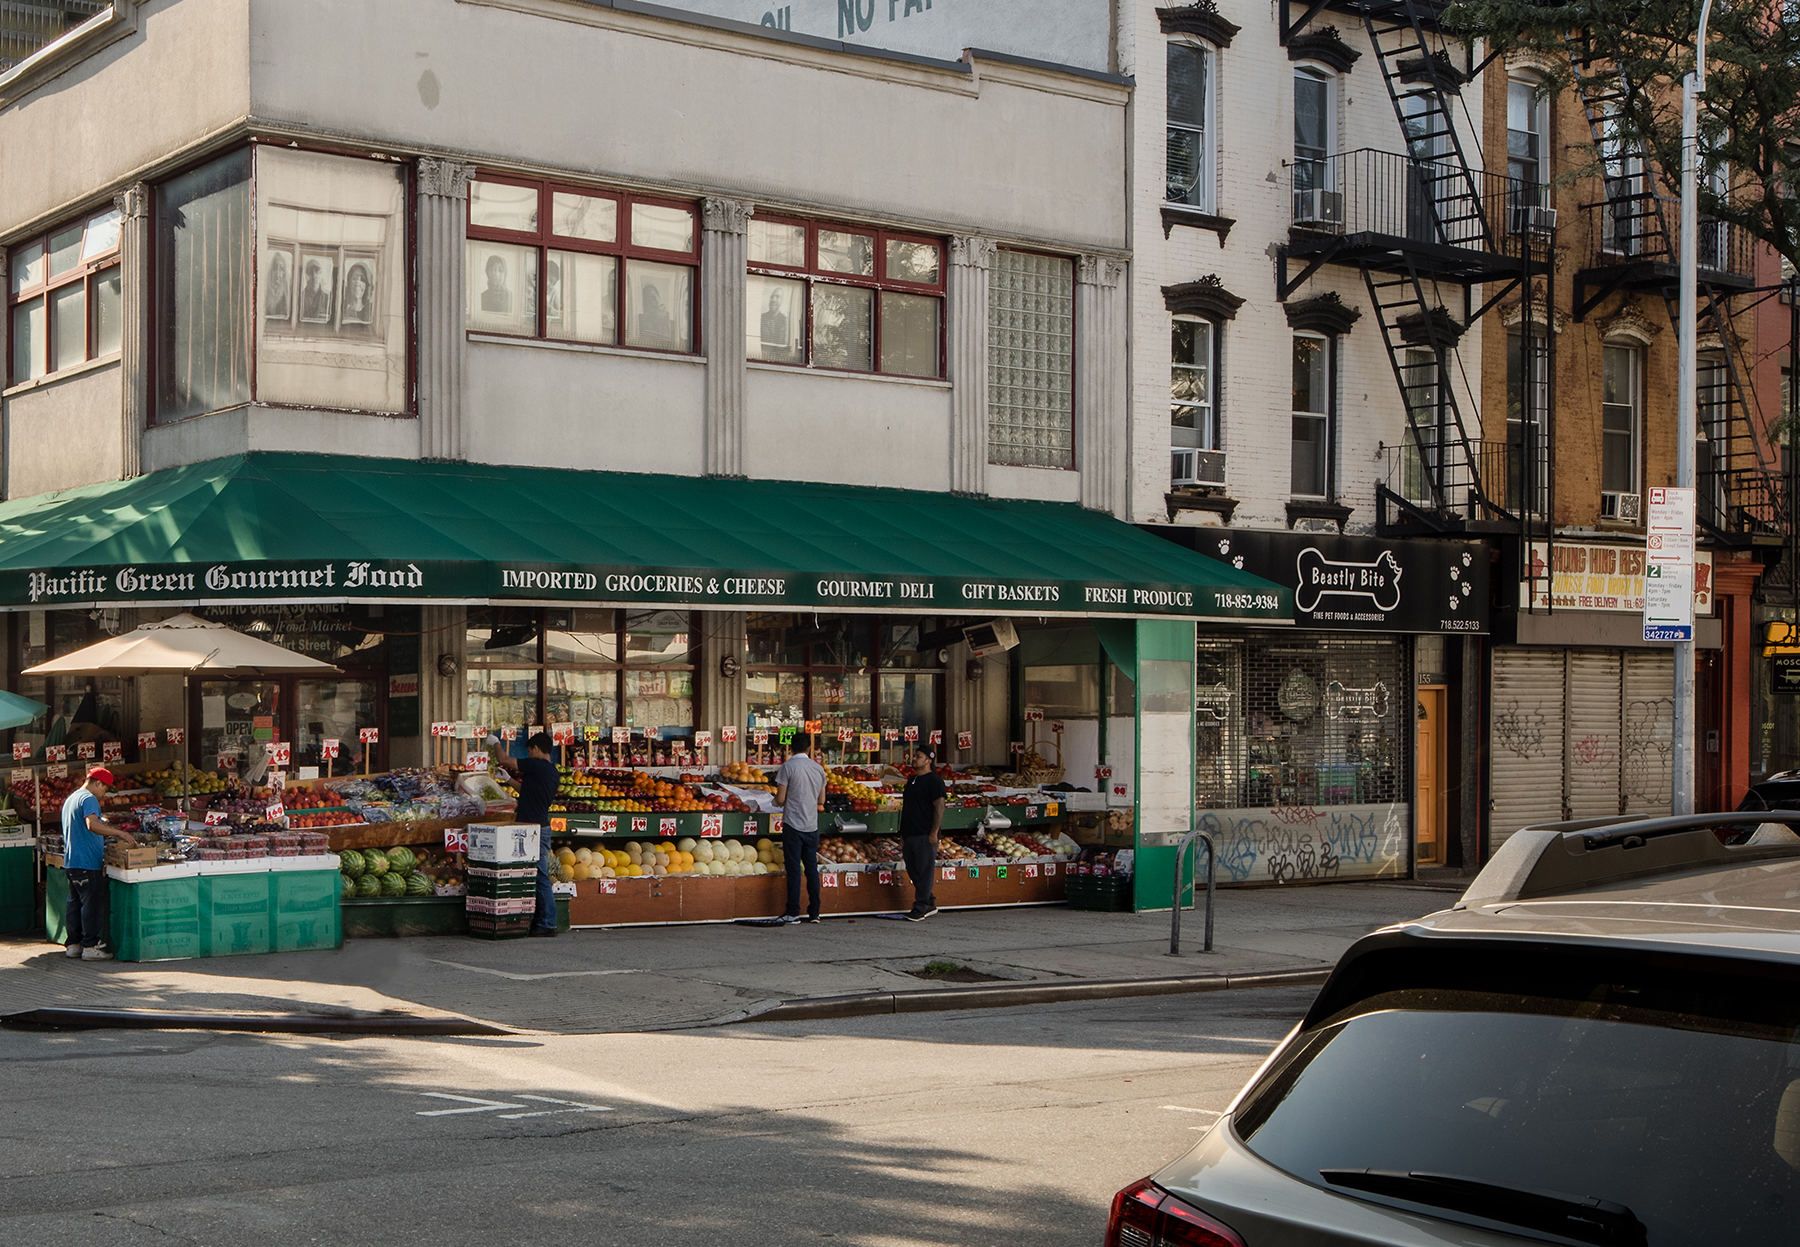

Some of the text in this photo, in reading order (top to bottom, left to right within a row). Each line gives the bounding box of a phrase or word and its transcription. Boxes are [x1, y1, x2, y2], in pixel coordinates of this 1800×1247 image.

[1553, 546, 1586, 573] HUNG
[1312, 567, 1385, 590] Beastly Bite
[1650, 565, 1658, 577] 2
[28, 561, 423, 603] Pacific Green Gourmet Food
[502, 569, 786, 597] IMPORTED GROCERIES & CHEESE
[817, 580, 935, 600] GOURMET DELI
[1586, 576, 1605, 594] FOOD
[962, 582, 1060, 602] GIFT BASKETS
[1084, 586, 1193, 608] FRESH PRODUCE
[1214, 592, 1280, 610] 718-852-9384
[1579, 596, 1593, 607] FREE
[1594, 597, 1618, 608] DELIVERY
[1313, 612, 1324, 620] FINE
[1325, 612, 1333, 620] PET
[1334, 612, 1349, 621] FOODS
[1354, 613, 1385, 621] ACCESSORIES
[278, 621, 308, 633] Food
[310, 620, 353, 632] Market
[1646, 631, 1674, 639] 342727
[298, 639, 331, 651] Street
[1419, 674, 1431, 684] 155
[226, 722, 252, 735] OPEN
